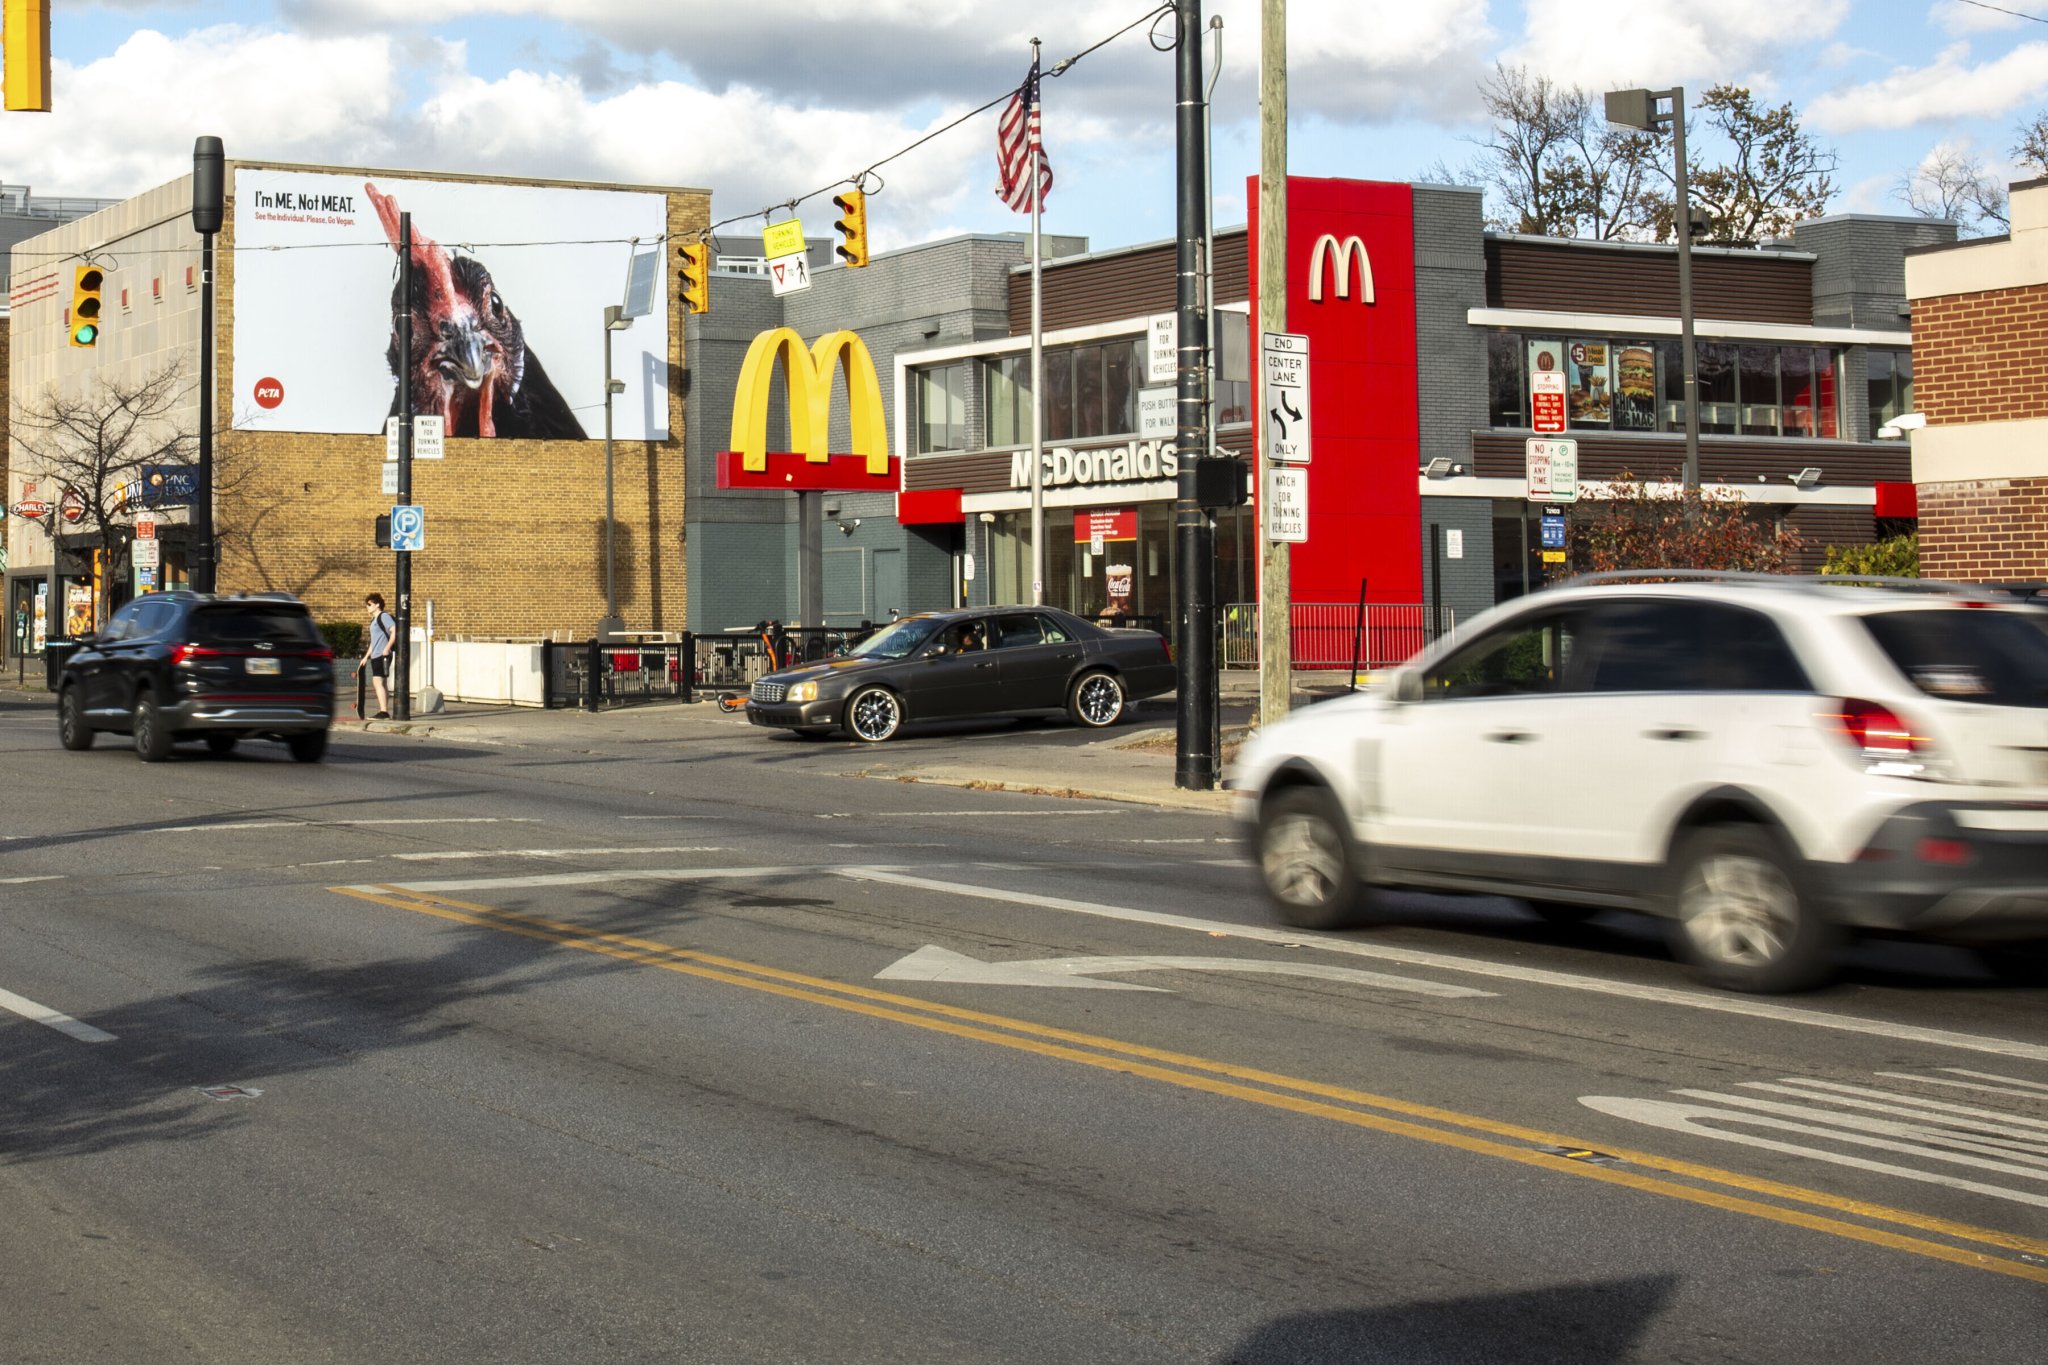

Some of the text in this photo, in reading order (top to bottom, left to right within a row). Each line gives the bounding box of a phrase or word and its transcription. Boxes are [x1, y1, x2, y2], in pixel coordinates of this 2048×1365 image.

[254, 190, 355, 213] I'm ME, Not MEAT.
[255, 211, 266, 220] See
[267, 212, 276, 221] the
[327, 216, 336, 224] Go
[772, 227, 794, 239] TURNING
[773, 238, 797, 250] VEHICLES
[1156, 319, 1173, 330] WATCH
[1159, 334, 1169, 345] FOR
[1274, 337, 1293, 349] END
[1153, 348, 1176, 360] TURNING
[1587, 347, 1604, 355] Meal
[1268, 356, 1302, 369] CENTER
[1588, 355, 1604, 363] Deal
[1153, 363, 1177, 375] VEHICLES
[1272, 371, 1297, 383] LANE
[1141, 398, 1177, 411] PUSH BUTTO
[1145, 416, 1175, 428] FOR WALK
[1613, 411, 1653, 427] BIG MAC
[418, 438, 439, 446] TURNING
[416, 447, 441, 455] VEHICLES
[1275, 443, 1298, 455] ONLY
[1535, 444, 1545, 454] NO
[1010, 439, 1178, 488] McDonald's
[1530, 455, 1550, 465] STOPPING
[1534, 467, 1546, 475] ANY
[1275, 475, 1296, 487] WATCH
[1533, 476, 1548, 485] TIME
[1278, 491, 1291, 502] FOR
[1272, 506, 1300, 518] TURNING
[1272, 522, 1302, 533] VEHICLES
